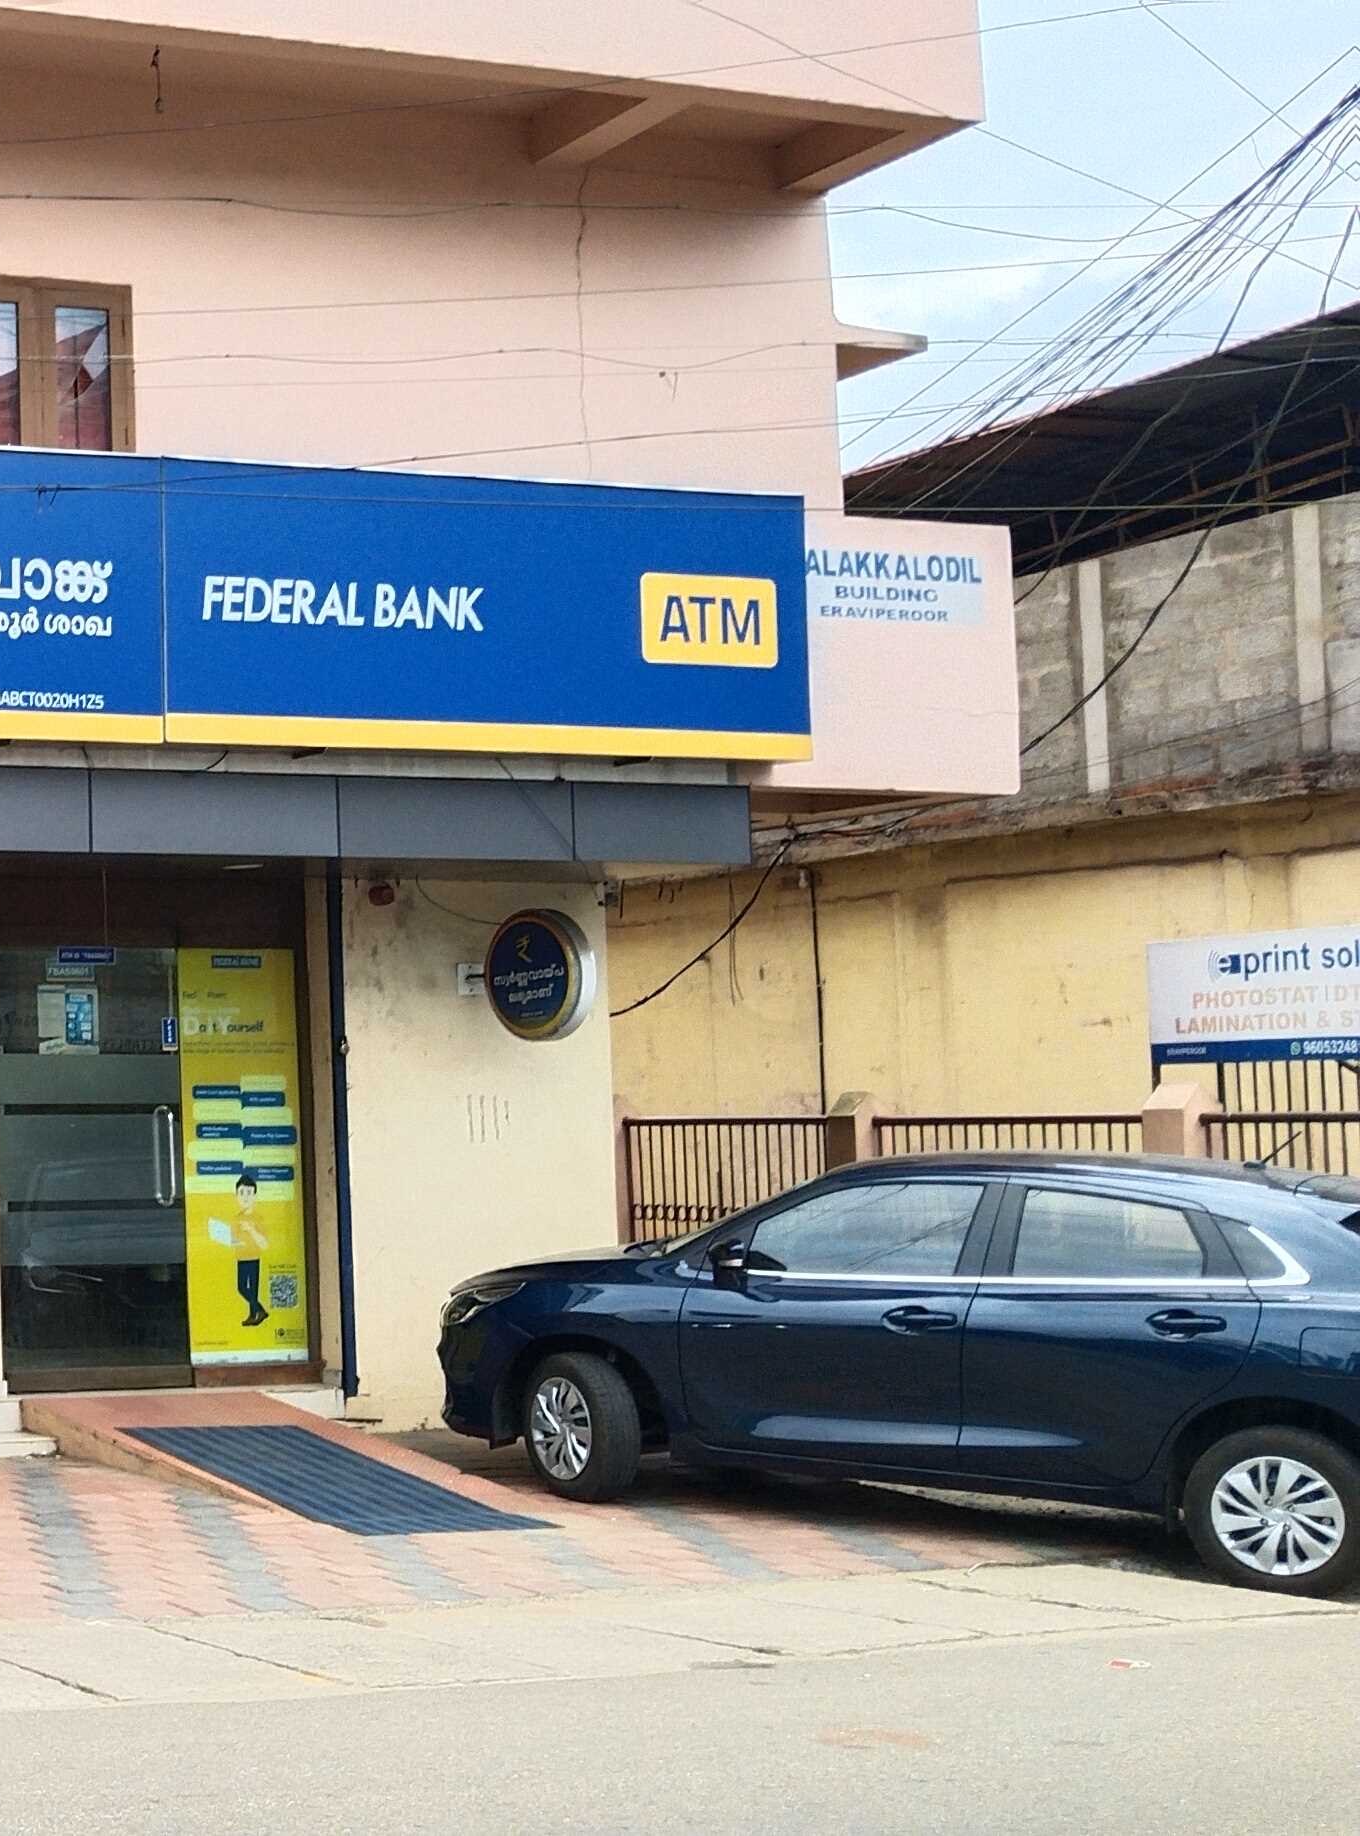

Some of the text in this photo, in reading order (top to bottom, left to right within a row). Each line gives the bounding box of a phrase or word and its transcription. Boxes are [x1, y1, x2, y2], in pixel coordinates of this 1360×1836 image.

[805, 549, 983, 584] ALAKKALODIL
[202, 575, 485, 632] FEDERAL BANK
[834, 584, 939, 603] BUILDING
[44, 613, 113, 638] ശാഖ
[658, 593, 763, 647] ATM
[820, 605, 950, 622] ERAVIPEROOR
[1192, 986, 1319, 1010] PHOTOSTAT
[1174, 1012, 1307, 1035] LAMINATION
